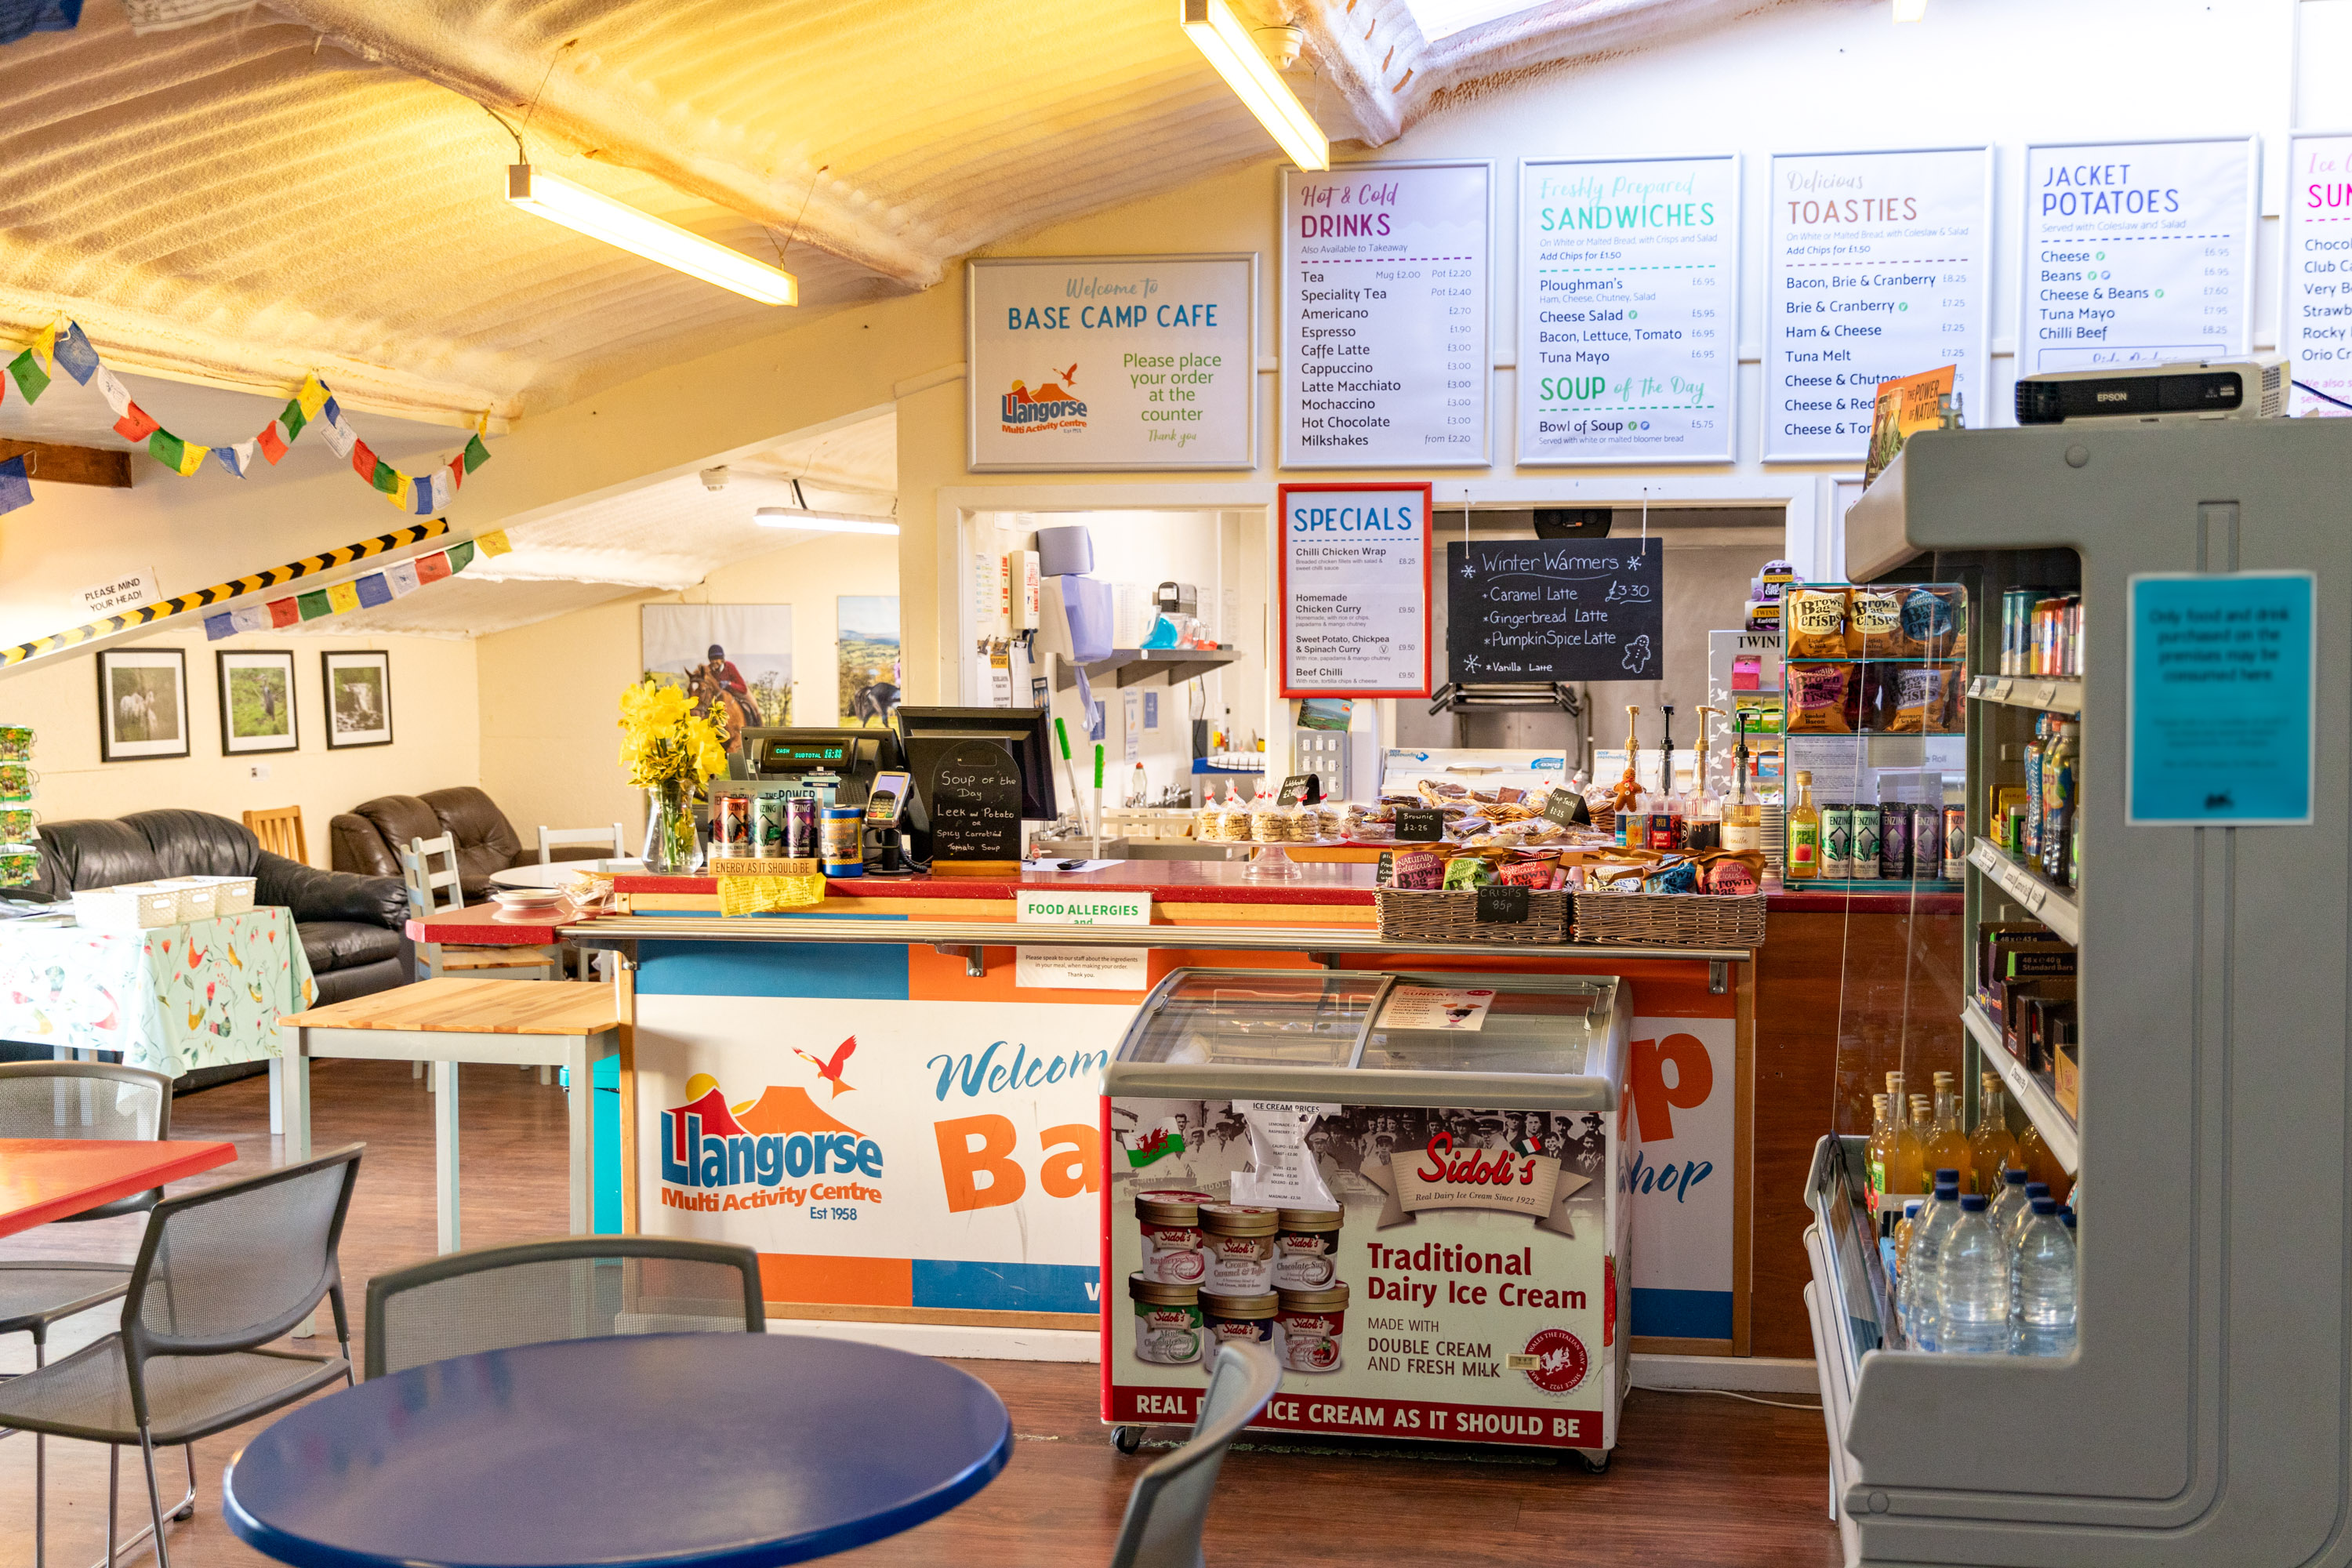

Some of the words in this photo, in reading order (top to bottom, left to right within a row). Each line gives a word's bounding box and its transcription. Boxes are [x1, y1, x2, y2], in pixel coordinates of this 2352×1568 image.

[1788, 170, 1864, 193] Delicious
[2043, 165, 2130, 187] JACKET
[1301, 185, 1340, 208] Hot
[1359, 183, 1399, 205] Cold
[2043, 189, 2179, 216] POTATOES
[1541, 202, 1713, 230] SANDWICHES
[1788, 198, 1917, 224] TOASTIES
[1301, 213, 1391, 238] DRINKS
[1369, 244, 1408, 252] Takeaway
[1560, 252, 1582, 261] Chips
[1584, 252, 1597, 261] for
[2042, 251, 2089, 263] Cheese
[2304, 260, 2336, 273] Club
[1301, 272, 1323, 282] Tea
[1376, 271, 1393, 281] Mug
[1787, 278, 1828, 289] Bacon,
[1832, 276, 1857, 287] Brie
[1860, 276, 1870, 286] &
[1874, 274, 1936, 288] Cranberry
[2042, 270, 2082, 281] Beans
[1066, 278, 1137, 298] Welcome
[1541, 278, 1623, 293] Ploughman's
[2304, 283, 2336, 296] Very
[1301, 289, 1359, 303] Speciality
[1364, 289, 1387, 299] Tea
[2041, 289, 2089, 301] Cheese
[2108, 287, 2149, 298] Beans
[1009, 307, 1070, 329] BASE
[1082, 306, 1147, 328] CAMP
[1157, 304, 1218, 327] CAFE
[1301, 308, 1368, 319] Americano
[1540, 311, 1584, 322] Cheese
[1589, 310, 1623, 321] Salad
[2040, 308, 2074, 320] Tuna
[2079, 307, 2114, 321] Mayo
[1302, 327, 1356, 340] Espresso
[1540, 332, 1579, 343] Bacon,
[1584, 331, 1631, 341] Lettuce,
[1635, 329, 1682, 340] Tomato
[1786, 326, 1816, 338] Ham
[1820, 326, 1830, 336] &
[1835, 325, 1882, 336] Cheese
[2039, 328, 2071, 339] Chilli
[2077, 326, 2107, 340] Beef
[2303, 328, 2346, 342] Rocky
[1301, 345, 1334, 358] Caffe
[1338, 344, 1370, 355] Latte
[1785, 351, 1818, 362] Tuna
[1823, 350, 1851, 361] Melt
[1124, 354, 1174, 367] Please
[1180, 354, 1221, 370] place
[1301, 363, 1373, 376] Cappuccino
[1131, 372, 1166, 388] your
[1171, 370, 1214, 384] order
[1302, 382, 1334, 392] Latte
[1338, 380, 1400, 391] Macchiato
[1149, 390, 1164, 401] at
[1169, 388, 1196, 401] the
[1540, 376, 1605, 401] SOUP
[1671, 376, 1704, 404] Day
[2097, 393, 2126, 401] EPSON
[1302, 398, 1375, 409] Mochaccino
[1142, 408, 1203, 421] counter
[1302, 417, 1323, 428] Hot
[1328, 416, 1390, 427] Chocolate
[1540, 421, 1570, 432] Bowl
[1574, 420, 1588, 434] of
[1591, 420, 1623, 434] Soup
[1302, 435, 1368, 446] Milkshakes
[1294, 507, 1411, 532] SPECIALS
[1362, 547, 1386, 557] Wrap
[1483, 550, 1540, 572] Winter
[1544, 550, 1619, 571] Warmers
[85, 586, 116, 601] PLEASE
[118, 579, 140, 590] MIND
[1490, 586, 1541, 601] Caramel
[1548, 588, 1578, 601] Latte
[90, 600, 114, 612] YOUR
[116, 590, 143, 604] HEAD!
[1336, 605, 1361, 615] Curry
[1490, 608, 1566, 629] Gingerbread
[1575, 609, 1608, 622] Latte
[1352, 636, 1389, 644] Chickpea
[1584, 630, 1616, 644] Latte
[1305, 645, 1336, 655] Spinach
[1338, 645, 1361, 655] Curry
[1493, 662, 1521, 672] Vanilla
[1529, 663, 1553, 672] Latte
[942, 771, 975, 786] Soup
[1000, 776, 1016, 785] the
[956, 788, 982, 800] Day
[1552, 793, 1563, 804] Flap
[1563, 797, 1576, 808] Jacks
[984, 808, 1014, 818] Potato
[717, 862, 744, 873] ENERGY
[748, 863, 757, 873] AS
[768, 863, 798, 873] SHOULD
[800, 863, 809, 873] BE
[1480, 889, 1521, 898] CRISPS
[1029, 904, 1064, 914] FOOD
[1068, 905, 1138, 916] ALLERGIES
[1493, 900, 1512, 913] 85p
[661, 1109, 884, 1189] Llangorse
[1417, 1131, 1536, 1185] Sidoli's
[661, 1186, 720, 1212] Multi
[722, 1185, 808, 1212] Activity
[811, 1182, 882, 1204] Centre
[811, 1207, 828, 1220] Est
[830, 1207, 858, 1221] 1958
[1367, 1242, 1531, 1276] Traditional
[1368, 1276, 1437, 1308] Dairy
[1449, 1280, 1486, 1305] Ice
[1499, 1283, 1587, 1309] Cream
[1368, 1317, 1404, 1331] MADE
[1408, 1319, 1439, 1332] WITH
[1368, 1338, 1428, 1355] DOUBLE
[1436, 1341, 1491, 1358] CREAM
[1528, 1336, 1544, 1352] WALES
[1559, 1333, 1581, 1350] ITALIAN
[1368, 1357, 1400, 1373] AND
[1408, 1359, 1454, 1375] FRESH
[1462, 1362, 1501, 1378] MILK
[1137, 1395, 1188, 1416] REAL
[1267, 1400, 1300, 1421] ICE
[1308, 1403, 1385, 1428] CREAM
[1393, 1409, 1420, 1428] AS
[1429, 1411, 1447, 1430] IT
[1457, 1412, 1543, 1438] SHOULD
[1553, 1418, 1580, 1438] BE
